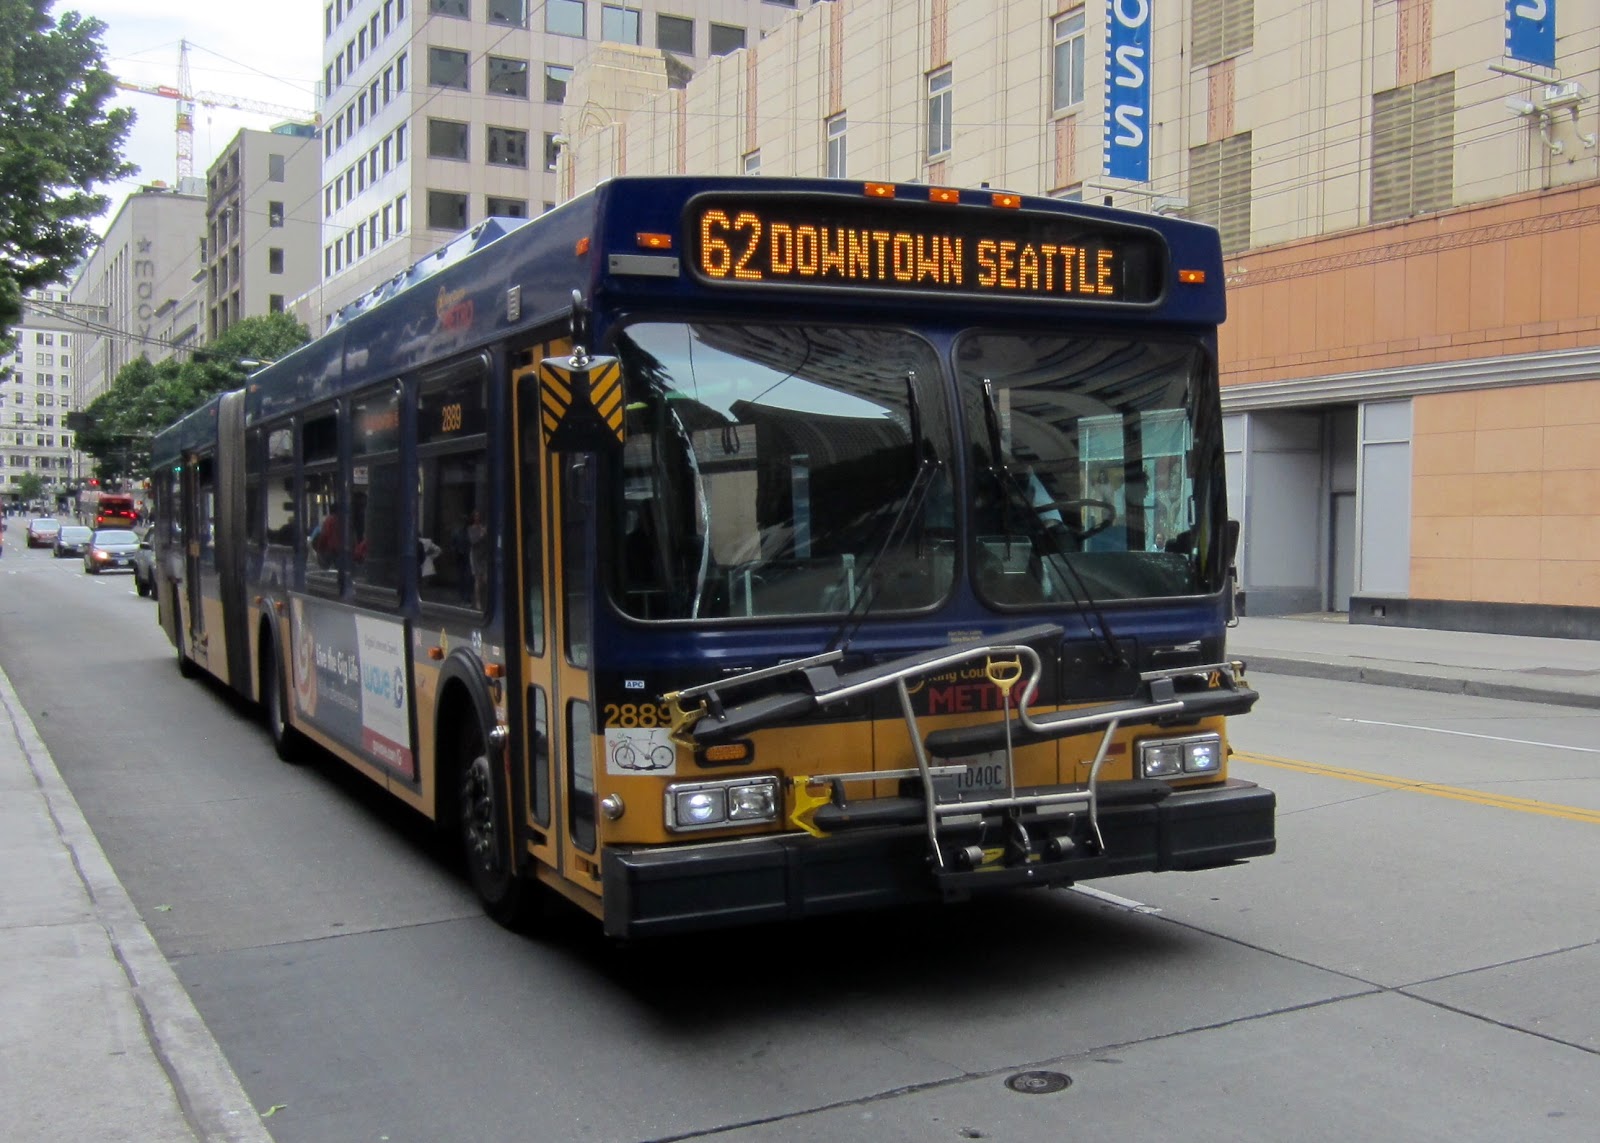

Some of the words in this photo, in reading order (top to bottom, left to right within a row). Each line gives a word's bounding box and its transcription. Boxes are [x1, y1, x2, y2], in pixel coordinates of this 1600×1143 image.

[702, 210, 763, 280] 62
[771, 223, 962, 284] DOWNTOWN
[977, 239, 1114, 294] SEATTLE
[135, 260, 154, 357] macy
[442, 403, 462, 432] 2889
[929, 681, 1039, 714] METRO
[604, 703, 672, 728] 2889
